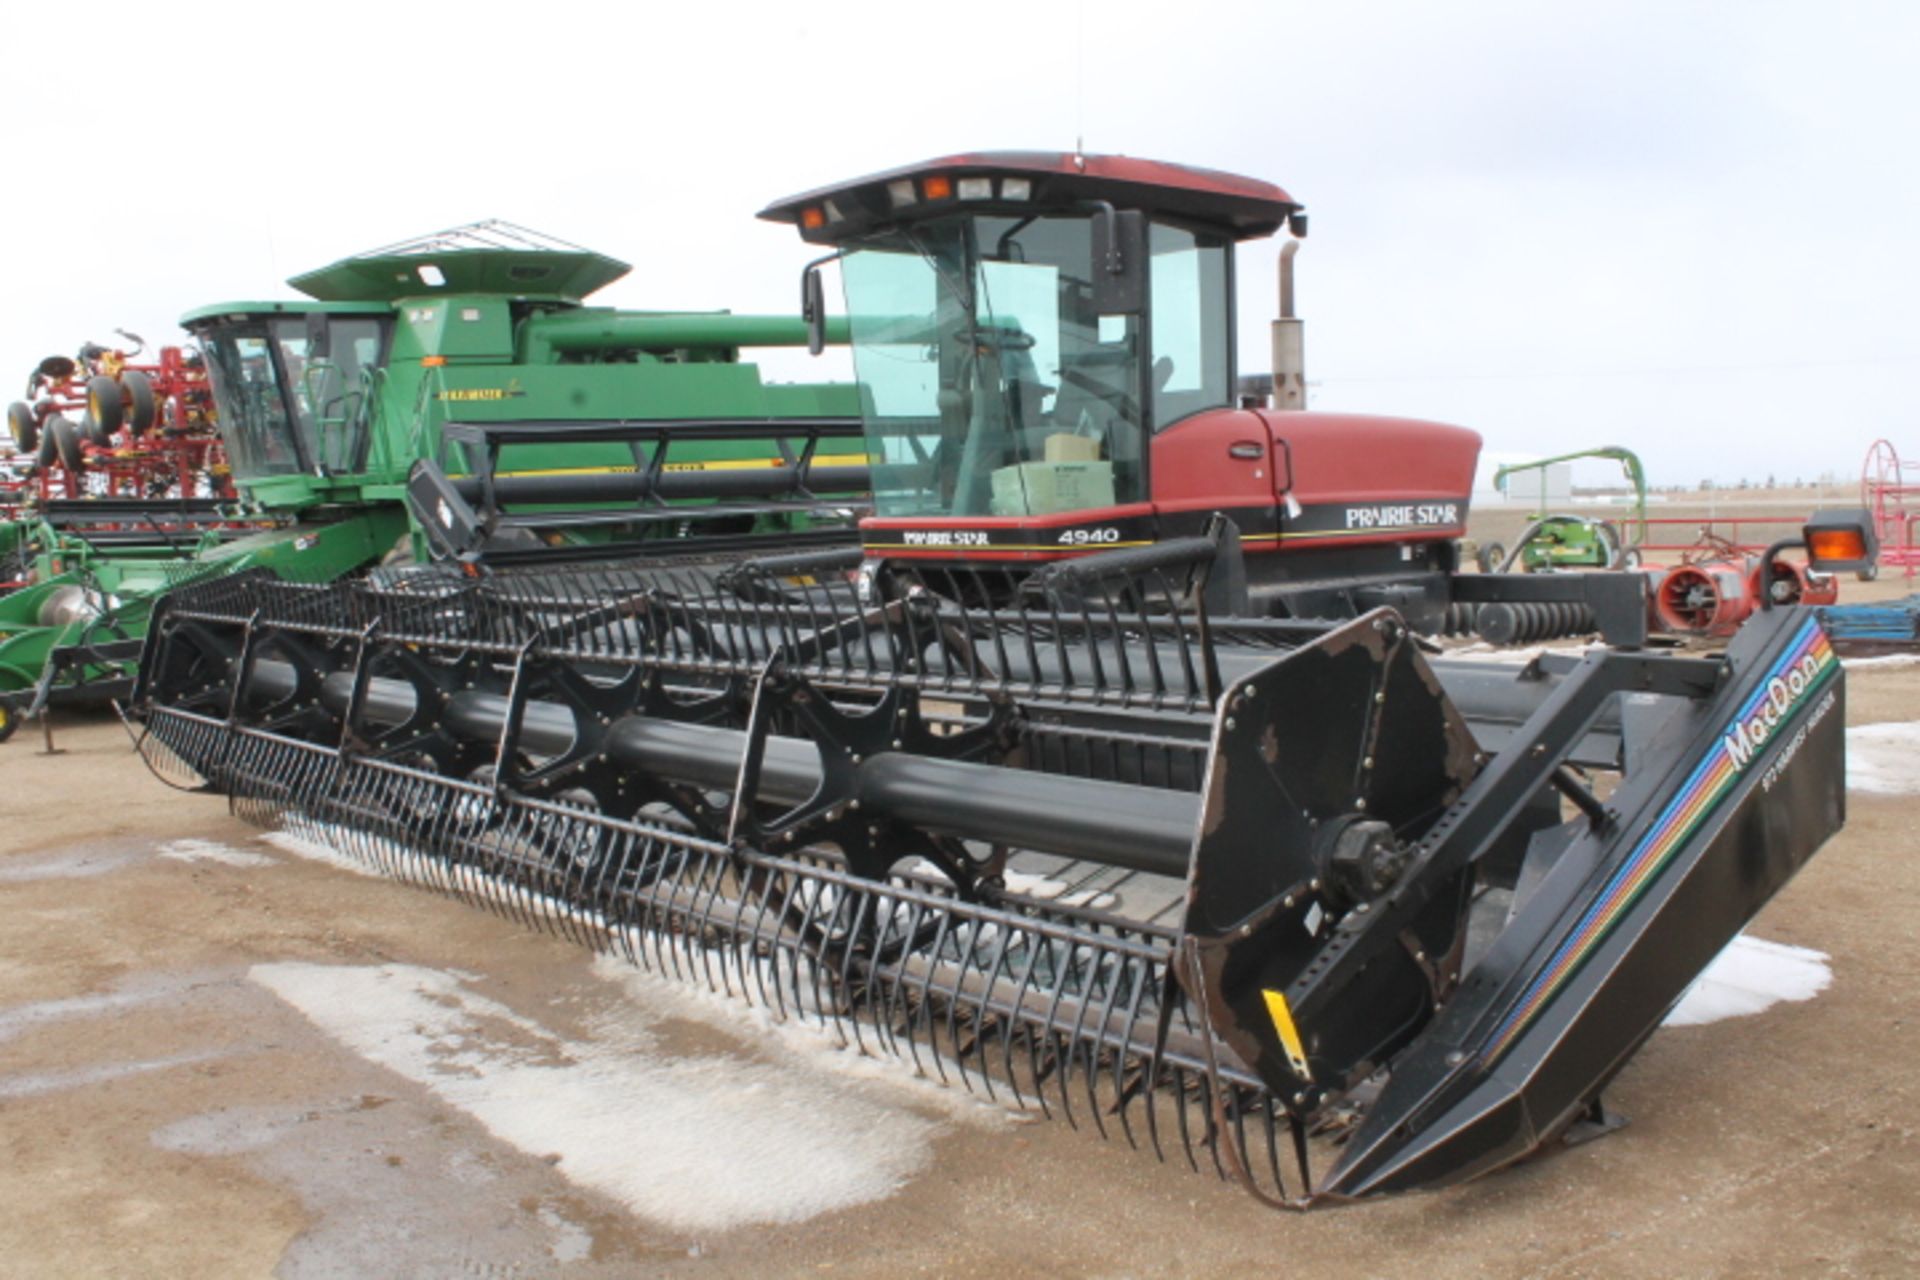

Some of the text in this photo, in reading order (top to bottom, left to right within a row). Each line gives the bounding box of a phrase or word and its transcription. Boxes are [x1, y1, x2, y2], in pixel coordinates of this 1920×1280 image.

[1346, 504, 1457, 528] PRAIRIE STAR
[1058, 528, 1119, 544] 4940
[1725, 654, 1820, 771] MacDon
